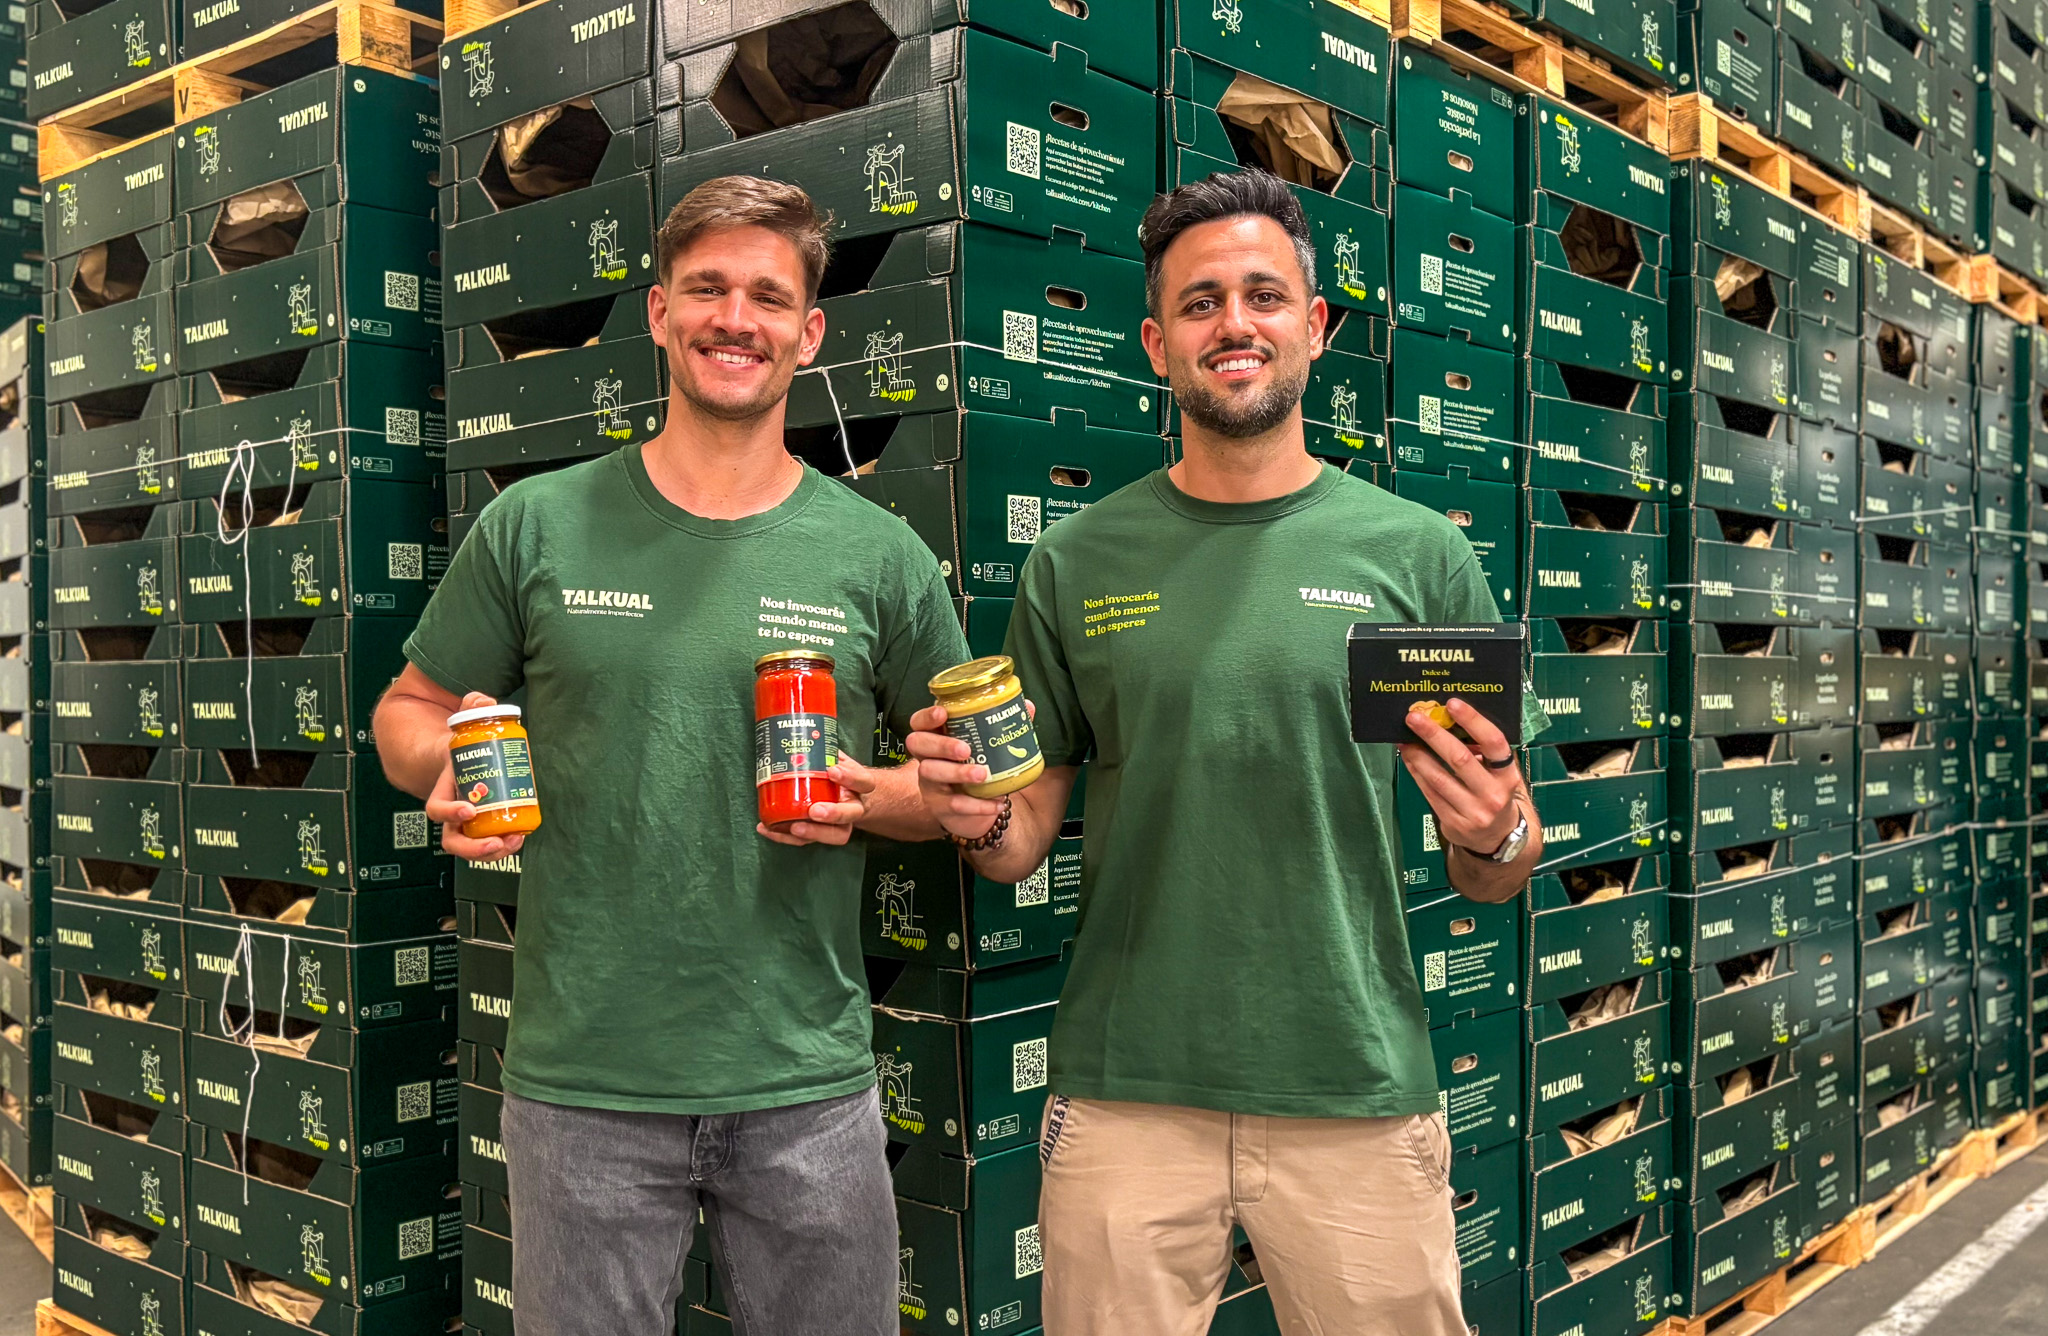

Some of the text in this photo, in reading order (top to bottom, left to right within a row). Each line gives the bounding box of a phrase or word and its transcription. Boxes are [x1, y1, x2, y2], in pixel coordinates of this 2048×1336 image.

[193, 0, 239, 27] TALKUAL
[571, 3, 635, 43] TALKUAL
[1322, 32, 1377, 73] TALKUAL
[35, 62, 73, 89] TALKUAL
[279, 102, 328, 133] TALKUAL
[1046, 133, 1070, 148] ¡Recetas
[1070, 141, 1077, 151] de
[1472, 131, 1481, 146] La
[125, 164, 164, 190] TALKUAL
[1629, 165, 1664, 194] TALKUAL
[455, 263, 510, 292] TALKUAL
[185, 319, 228, 343] TALKUAL
[1042, 318, 1067, 330] ¡Recetas
[1068, 322, 1075, 331] de
[1540, 310, 1582, 335] TALKUAL
[50, 355, 85, 376] TALKUAL
[1703, 350, 1734, 373] TALKUAL
[457, 413, 513, 438] TALKUAL
[186, 447, 231, 470] TALKUAL
[1538, 441, 1580, 462] TALKUAL
[53, 470, 90, 491] TALKUAL
[1702, 464, 1733, 484] TALKUAL
[1046, 498, 1070, 508] ¡Recetas
[1072, 500, 1078, 508] de
[942, 564, 951, 572] XL
[1538, 570, 1580, 587] TALKUAL
[55, 587, 90, 602] TALKUAL
[190, 576, 232, 593] TALKUAL
[1701, 581, 1733, 597] TALKUAL
[562, 589, 653, 610] TALKUAL
[760, 596, 845, 619] Nos invocarás
[1084, 591, 1160, 609] Nos invocarás
[1299, 587, 1375, 608] TALKUAL
[759, 612, 848, 634] cuando menos
[1084, 604, 1160, 623] cuando menos
[758, 627, 834, 646] te lo esperes
[1085, 618, 1146, 637] te lo esperes
[1398, 649, 1474, 662] TALKUAL
[1422, 669, 1450, 677] Dulce de
[1370, 680, 1504, 693] Membrillo artesano
[56, 702, 91, 717] TALKUAL
[193, 703, 235, 719] TALKUAL
[1701, 695, 1733, 709] TALKUAL
[777, 719, 816, 729] TALKUAL
[985, 703, 1021, 725] TALKUAL
[781, 738, 815, 748] Sofrito
[988, 723, 1030, 748] Calabacín
[455, 747, 493, 763] TALKUAL
[457, 768, 503, 785] Melocotón
[58, 815, 93, 832] TALKUAL
[1702, 807, 1733, 824] TALKUAL
[196, 829, 238, 847] TALKUAL
[1542, 823, 1580, 843] ALKUAL
[58, 928, 93, 948] TALKUAL
[1702, 919, 1733, 939] TALKUAL
[949, 936, 958, 945] XL
[196, 953, 240, 977] TALKUAL
[1540, 949, 1582, 973] TALKUAL
[471, 993, 510, 1017] TALKU
[58, 1042, 93, 1064] TALKUAL
[1702, 1031, 1733, 1054] TALKUAL
[197, 1079, 240, 1104] TALKUAL
[1541, 1074, 1583, 1101] TALKUAL
[947, 1123, 955, 1131] XL
[471, 1135, 507, 1162] TALK
[1702, 1144, 1734, 1169] TALKUAL
[58, 1155, 93, 1180] TALKUAL
[197, 1204, 241, 1235] TALKUAL
[1542, 1199, 1584, 1230] TALKUAL
[1702, 1257, 1735, 1285] TALKUAL
[59, 1269, 93, 1297] TALKUAL
[475, 1278, 514, 1309] TALKU
[948, 1312, 957, 1321] XL
